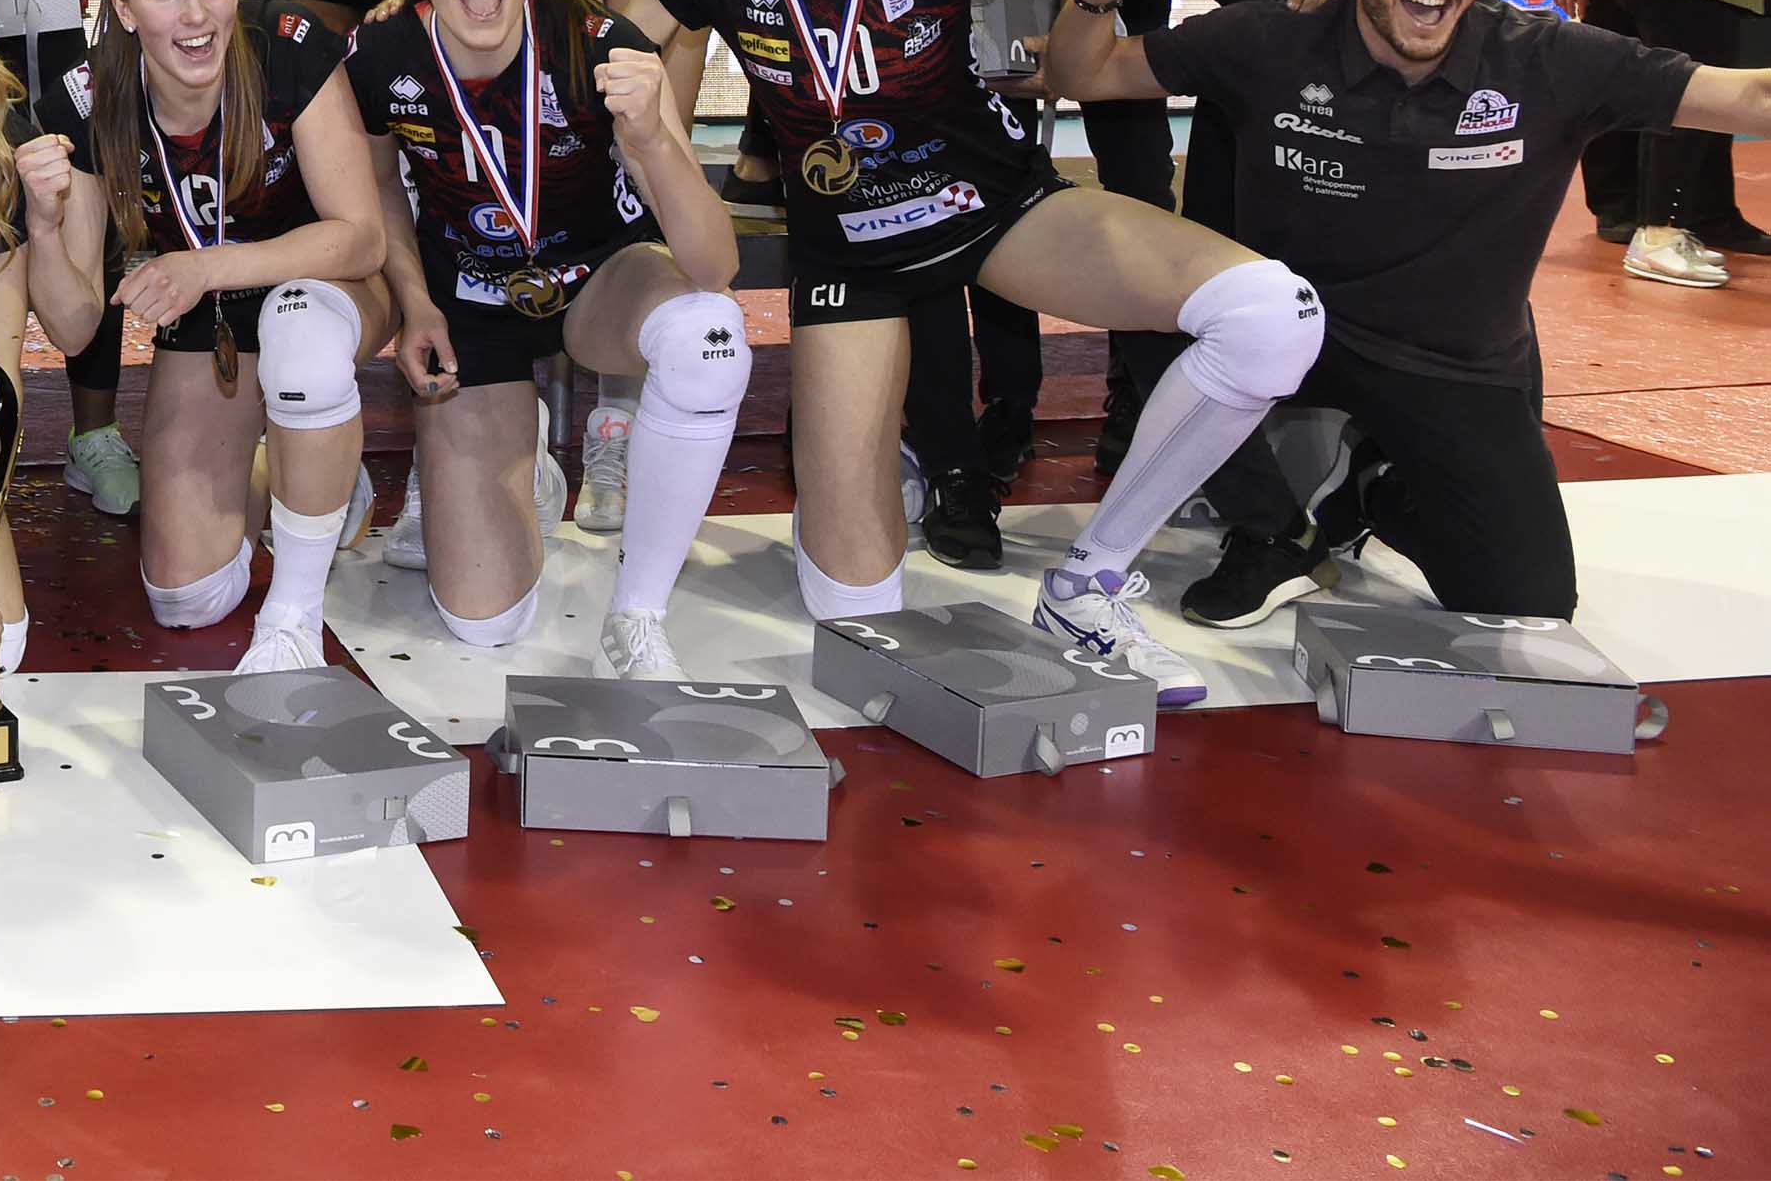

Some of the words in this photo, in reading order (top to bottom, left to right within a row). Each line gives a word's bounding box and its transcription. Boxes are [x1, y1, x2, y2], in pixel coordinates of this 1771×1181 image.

[746, 7, 785, 26] errea
[1461, 106, 1516, 123] ASPTT
[1274, 113, 1364, 144] Ricola
[1459, 117, 1514, 131] MULHOUSE
[1275, 145, 1344, 179] Kara
[1436, 153, 1490, 161] VINCI
[180, 174, 235, 226] 12
[1315, 187, 1359, 199] patrimoine
[845, 204, 936, 233] VINCI
[277, 301, 308, 315] errea
[703, 345, 736, 360] errea
